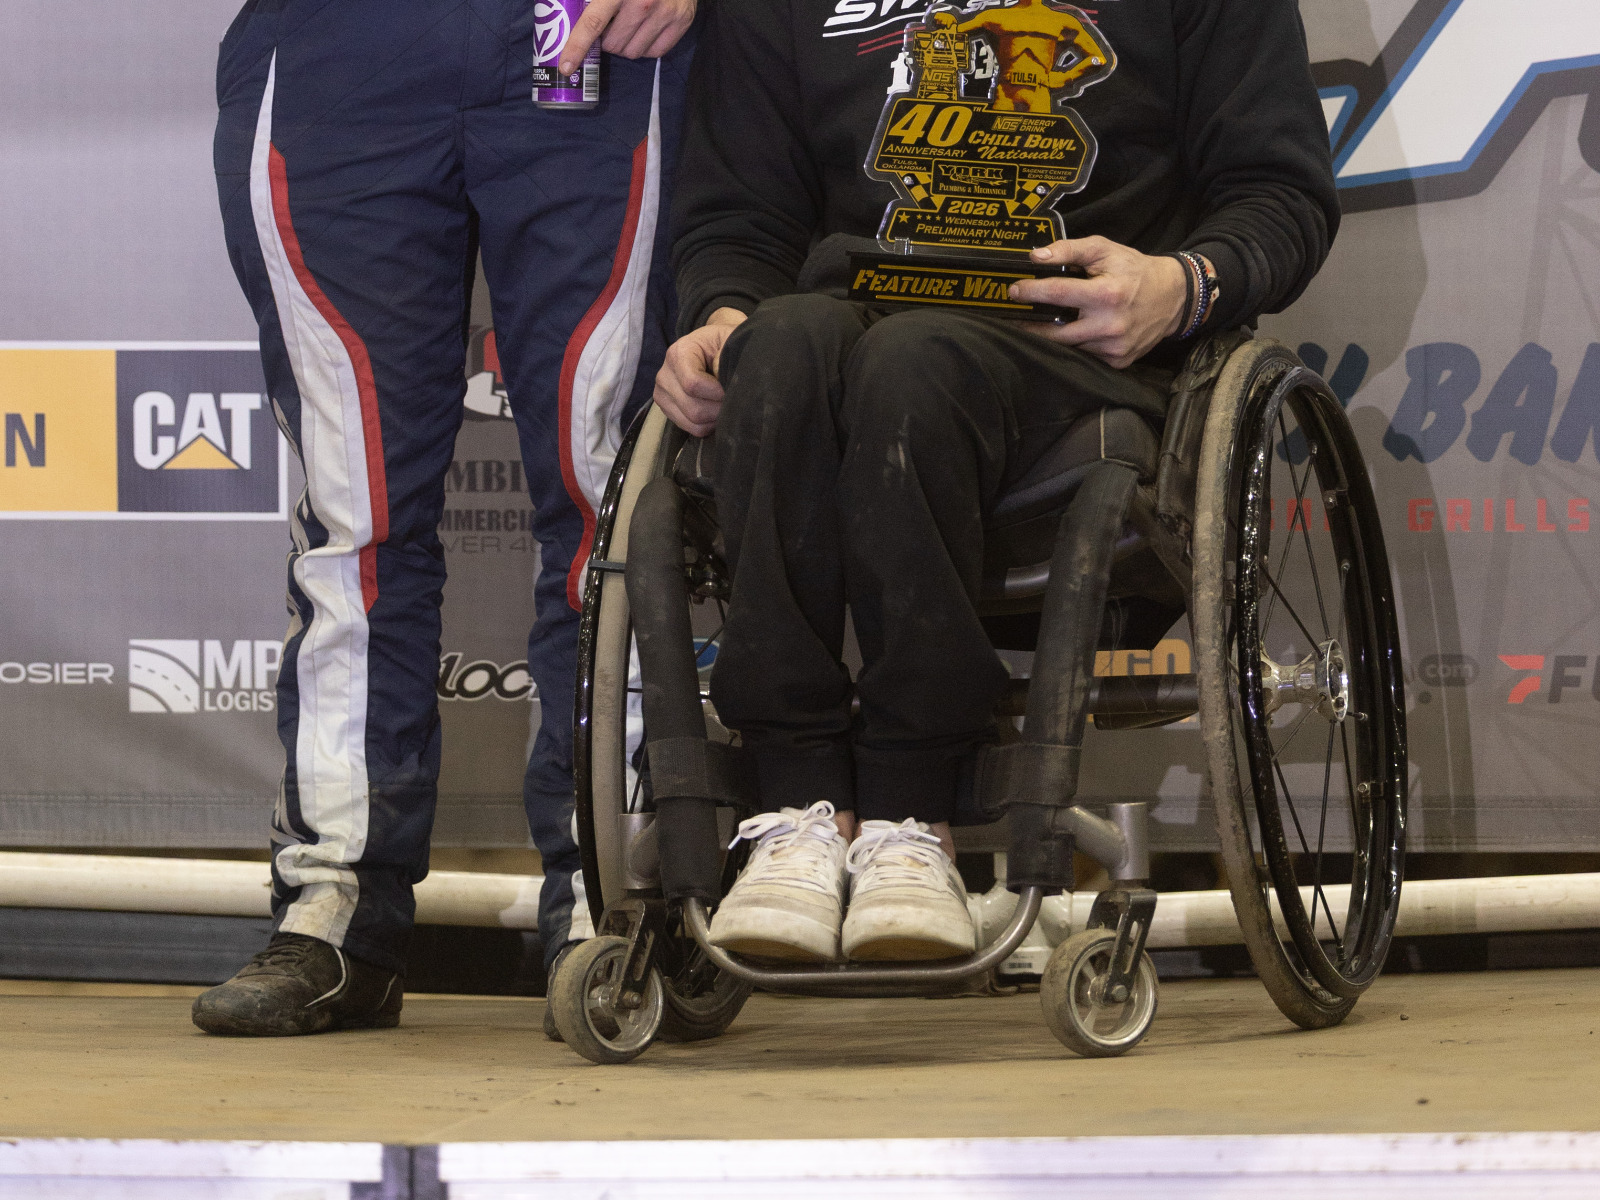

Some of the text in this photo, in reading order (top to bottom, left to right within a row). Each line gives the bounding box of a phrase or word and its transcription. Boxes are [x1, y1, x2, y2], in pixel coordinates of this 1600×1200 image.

[1011, 71, 1037, 85] TULSA
[1019, 125, 1047, 133] DRINK
[1022, 118, 1057, 127] ENERGY
[968, 130, 1077, 151] CHILI BOWL
[884, 144, 968, 158] ANNIVERSARY
[977, 146, 1066, 160] Nationals
[882, 163, 927, 172] OKLAHOMA
[947, 200, 1000, 216] 2026
[945, 216, 1001, 227] WEDNESDAY
[915, 223, 1028, 241] PRELIMINARY NIGHT
[939, 237, 969, 245] JANUARY
[852, 269, 958, 296] FEATURE
[133, 391, 262, 470] CAT
[1407, 497, 1590, 532] GRILLS
[1548, 655, 1600, 704] F
[203, 691, 278, 711] LOGIS
